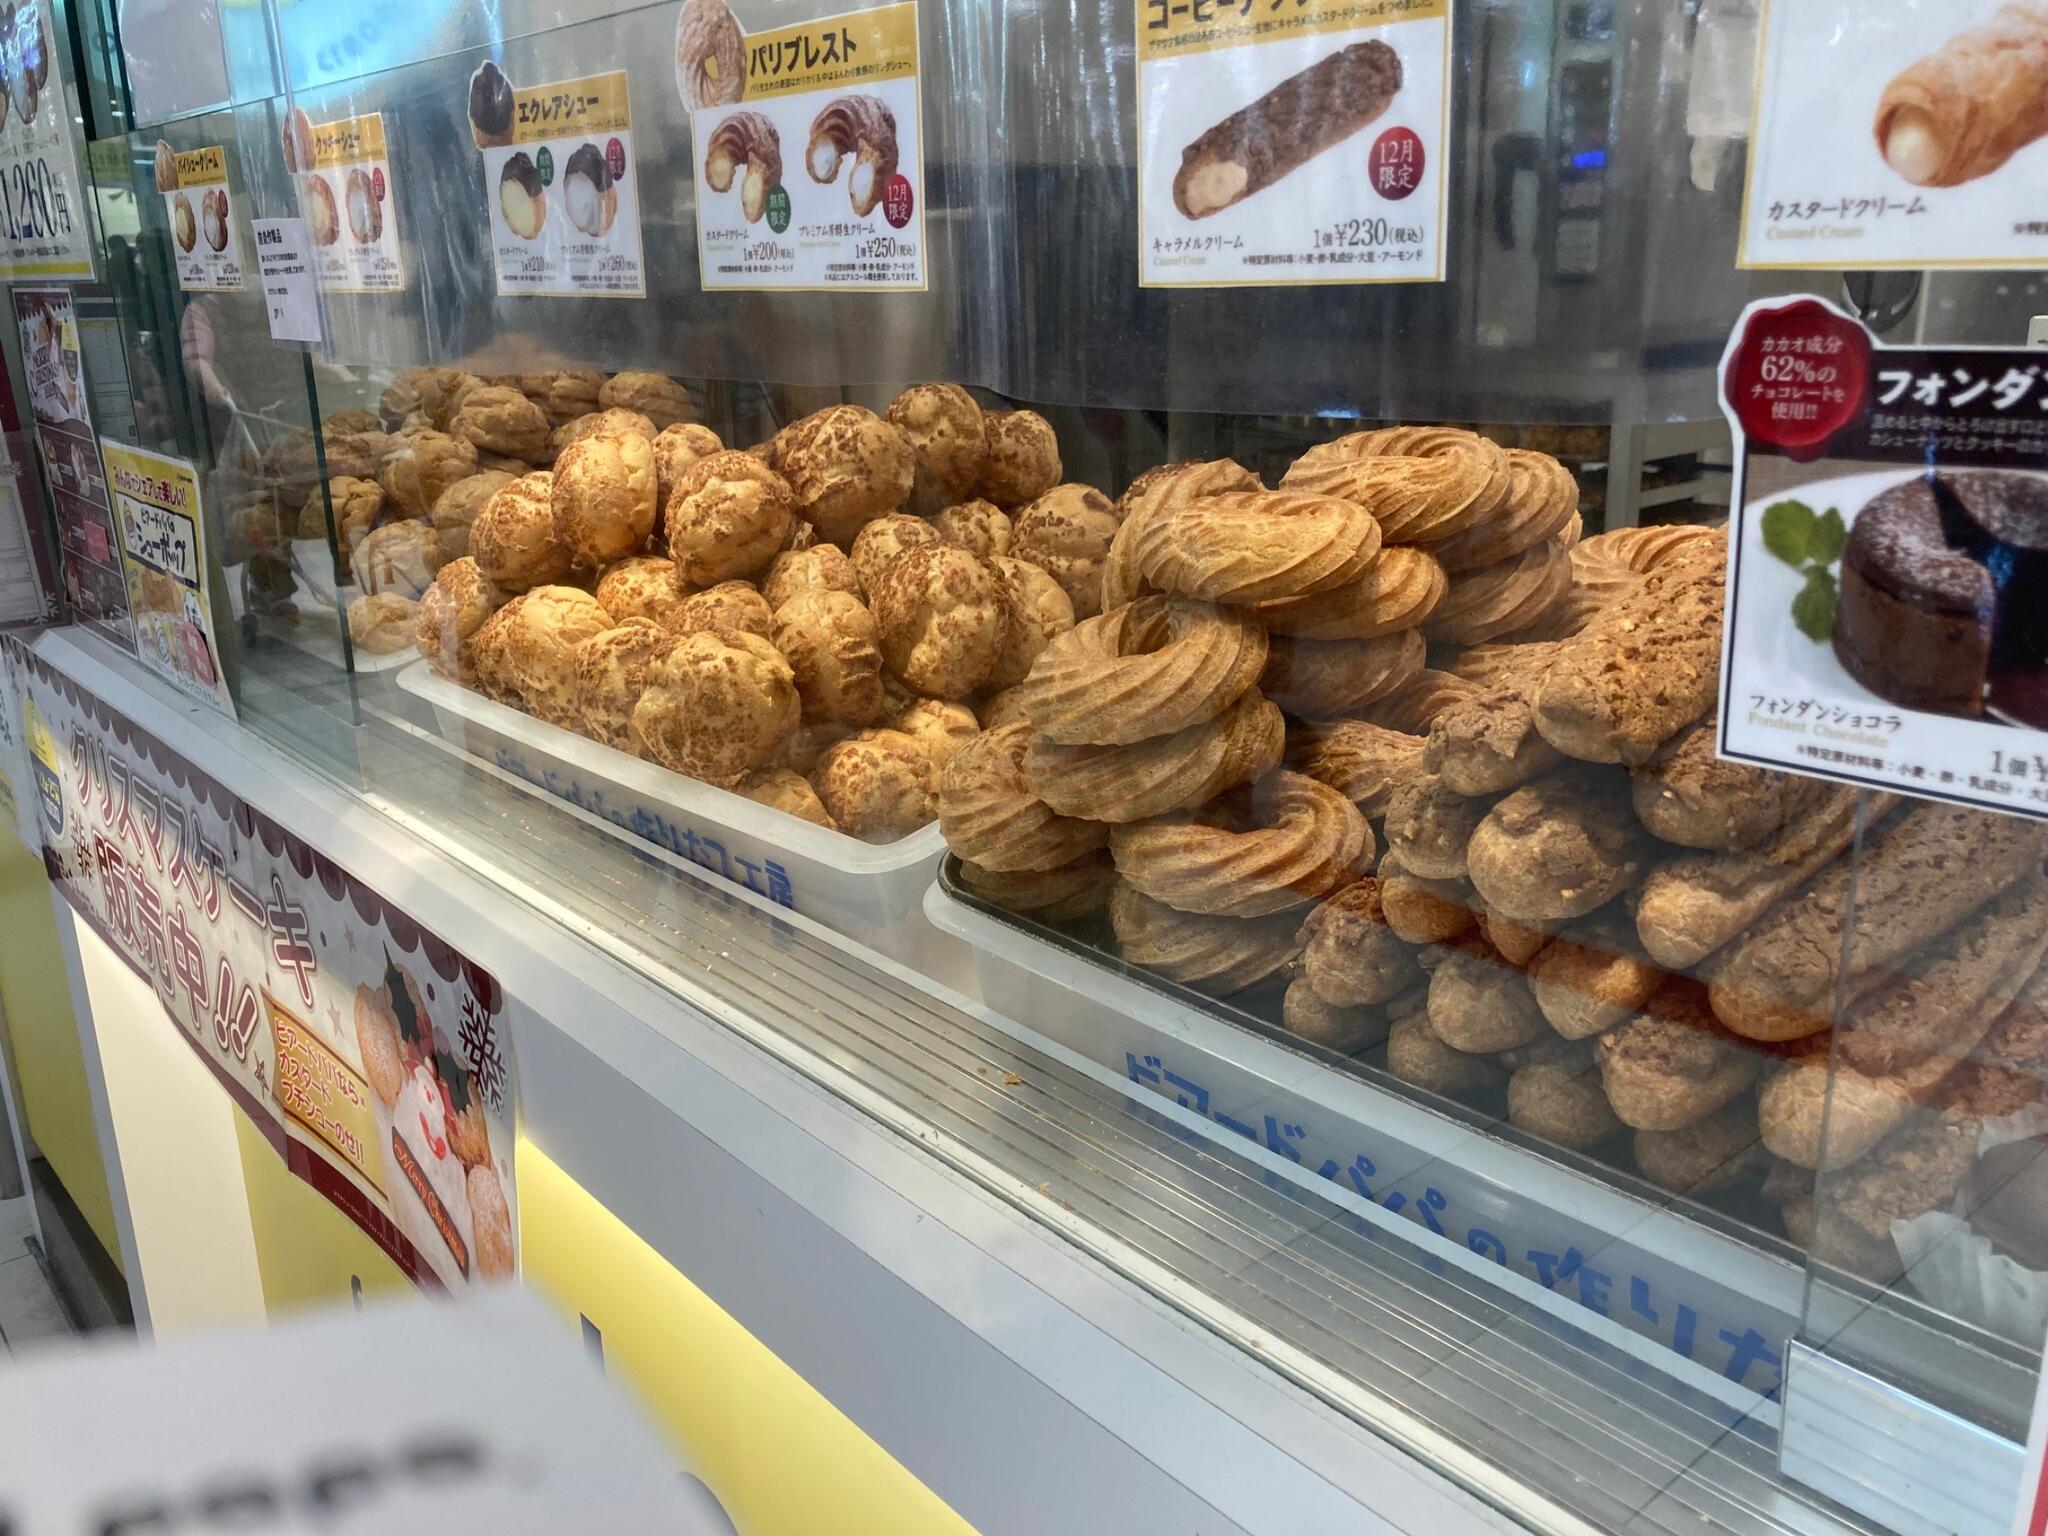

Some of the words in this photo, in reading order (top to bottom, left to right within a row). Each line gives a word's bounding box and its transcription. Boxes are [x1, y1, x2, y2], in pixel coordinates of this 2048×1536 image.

[750, 27, 857, 77] パリブレスト
[518, 94, 599, 125] エクレアシュー
[1378, 140, 1413, 164] 12月
[1378, 165, 1414, 189] 限定
[888, 184, 908, 202] 12月
[770, 209, 787, 227] 限定
[889, 203, 909, 221] 限定
[1767, 195, 1927, 222] カスタードクリーム
[706, 229, 750, 242] カスタードクリーム
[1152, 234, 1244, 254] キャラメルクリーム
[1760, 333, 1844, 354] カカオ成分
[1760, 355, 1837, 382] 62%の
[1750, 383, 1846, 403] チョコレートを
[1750, 694, 1902, 733] フォンダンショコラ
[1749, 711, 1807, 734] Fondant
[1812, 722, 1889, 748] Chocolate
[71, 723, 317, 1011] クリスマスケーキ
[278, 1049, 332, 1105] カスタード
